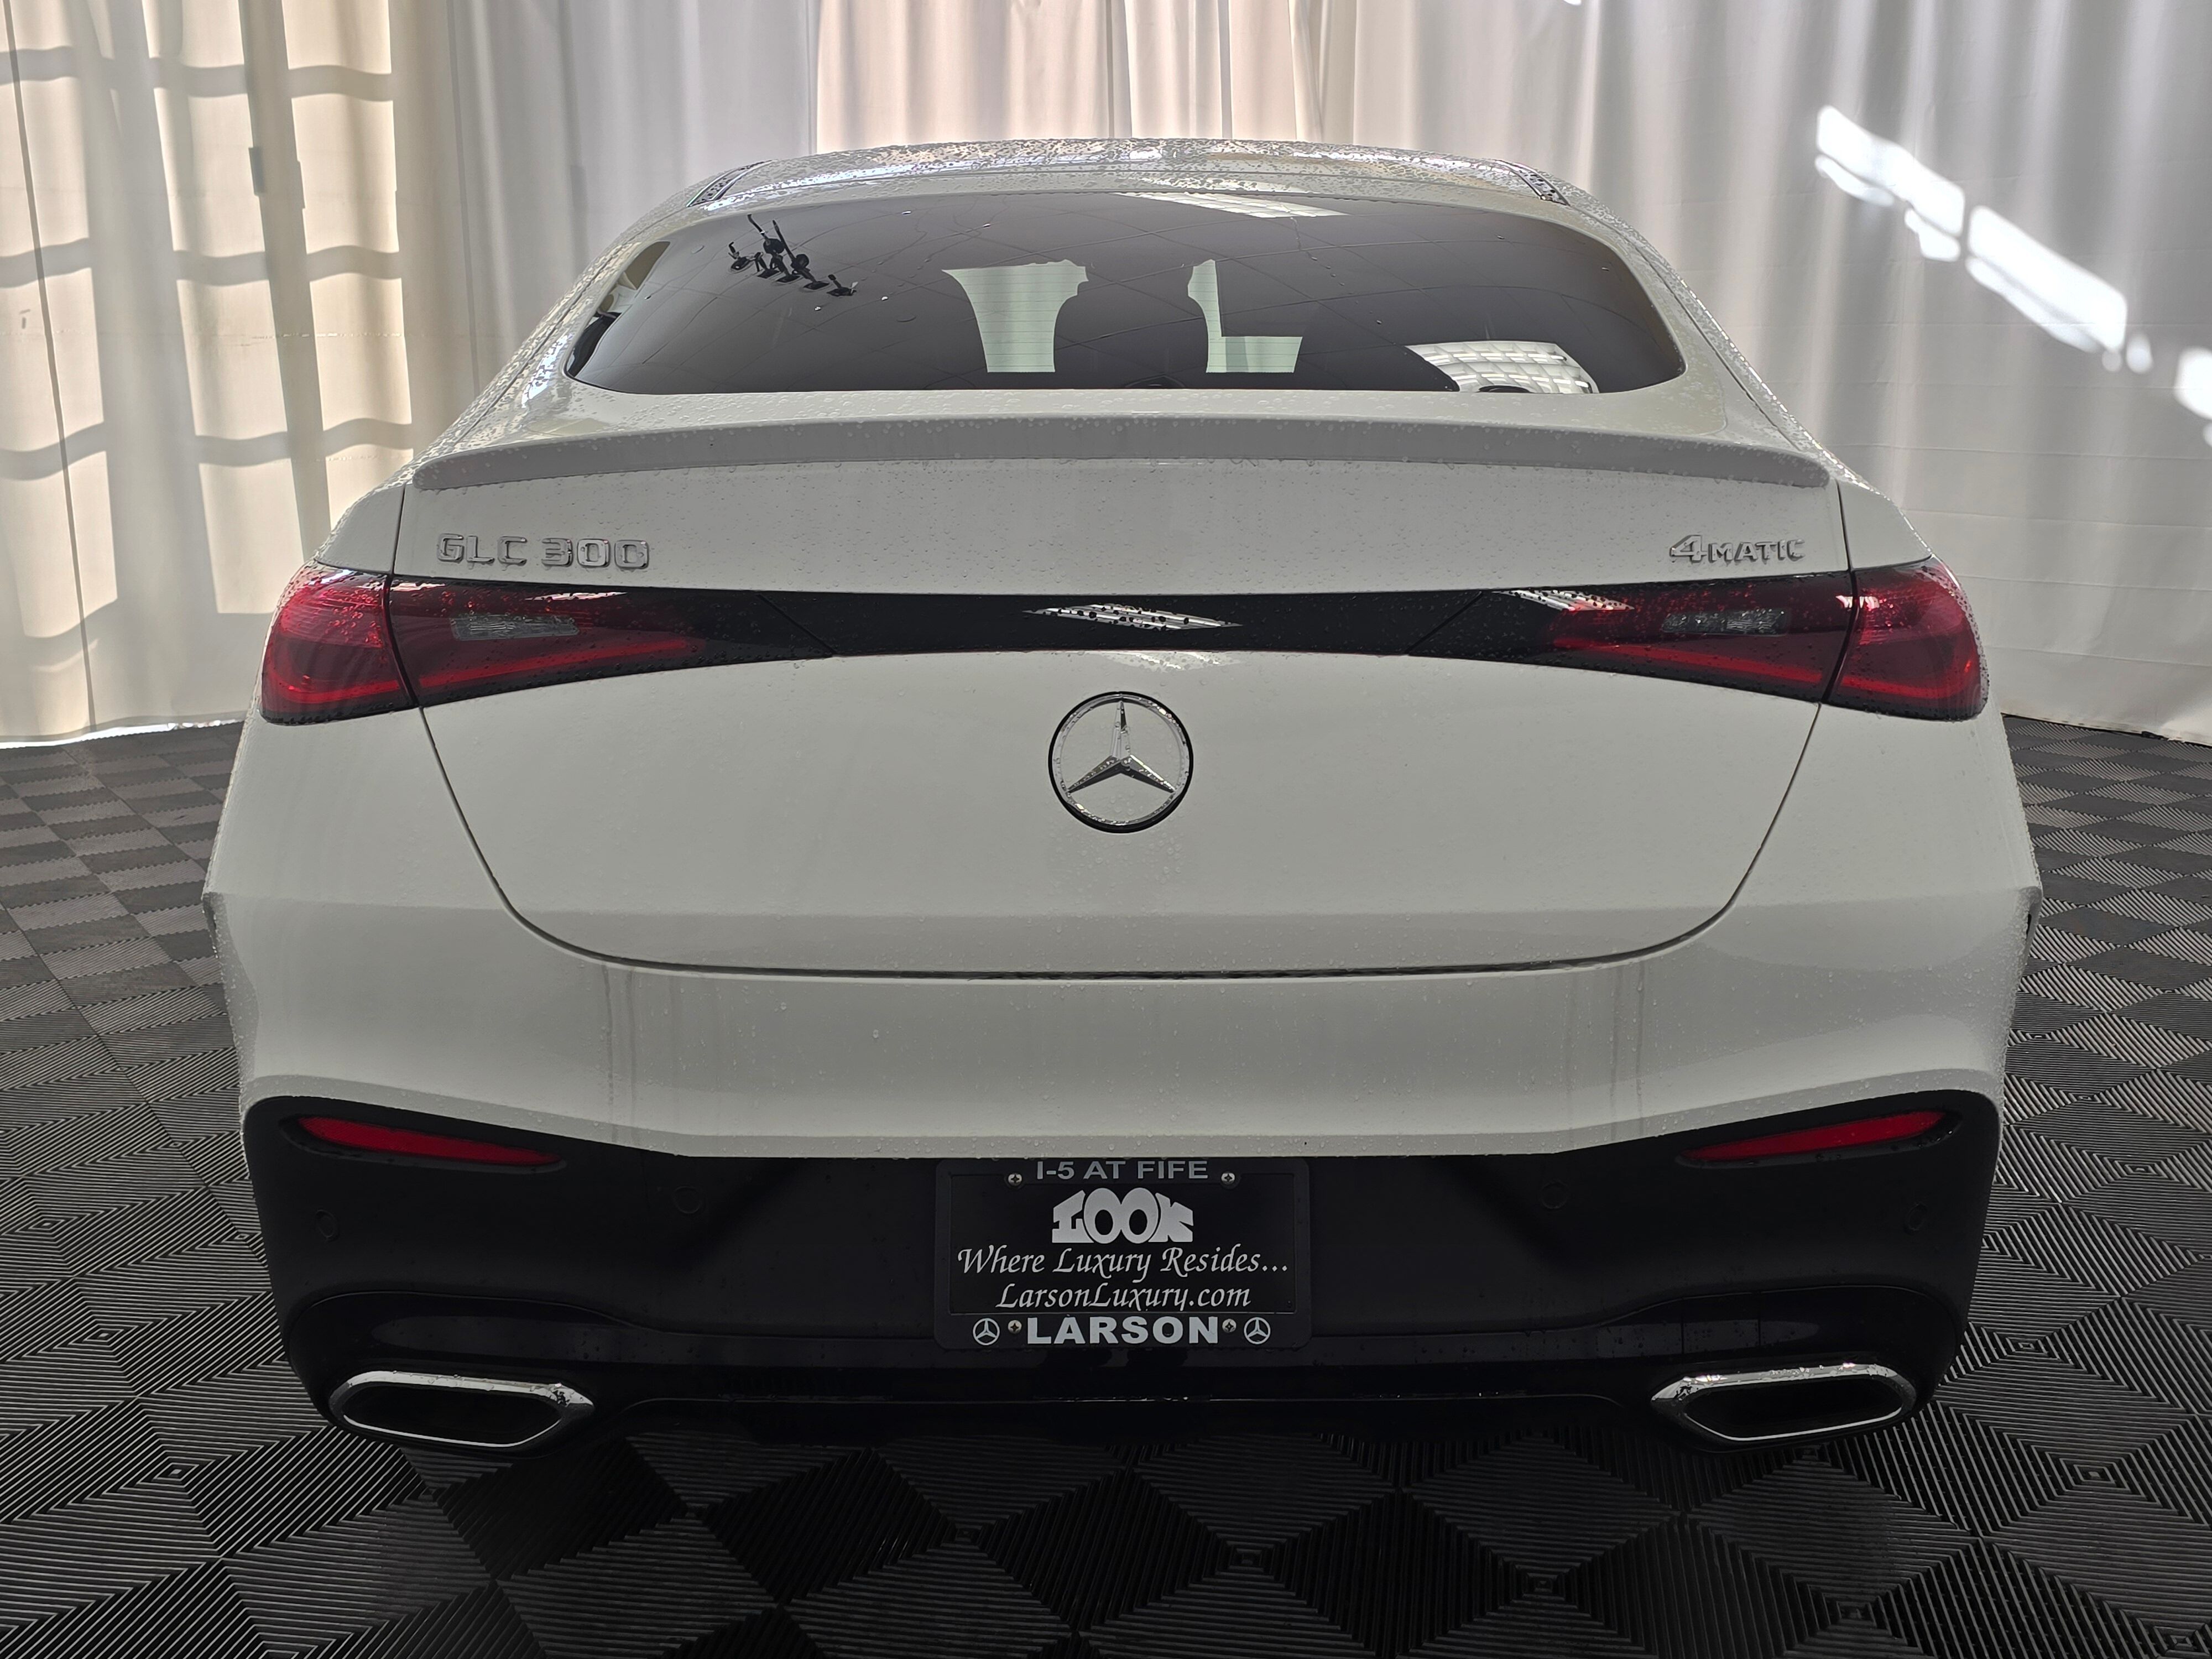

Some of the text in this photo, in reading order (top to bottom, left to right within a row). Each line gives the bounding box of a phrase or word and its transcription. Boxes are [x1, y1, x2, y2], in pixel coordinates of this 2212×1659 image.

[436, 533, 649, 569] GLC 300
[1036, 1160, 1209, 1180] I-5 AT FIFE
[957, 1244, 1288, 1283] Where Luxury Resides...
[995, 1282, 1251, 1311] LarsonLuxury.com
[1026, 1316, 1218, 1344] LARSON
